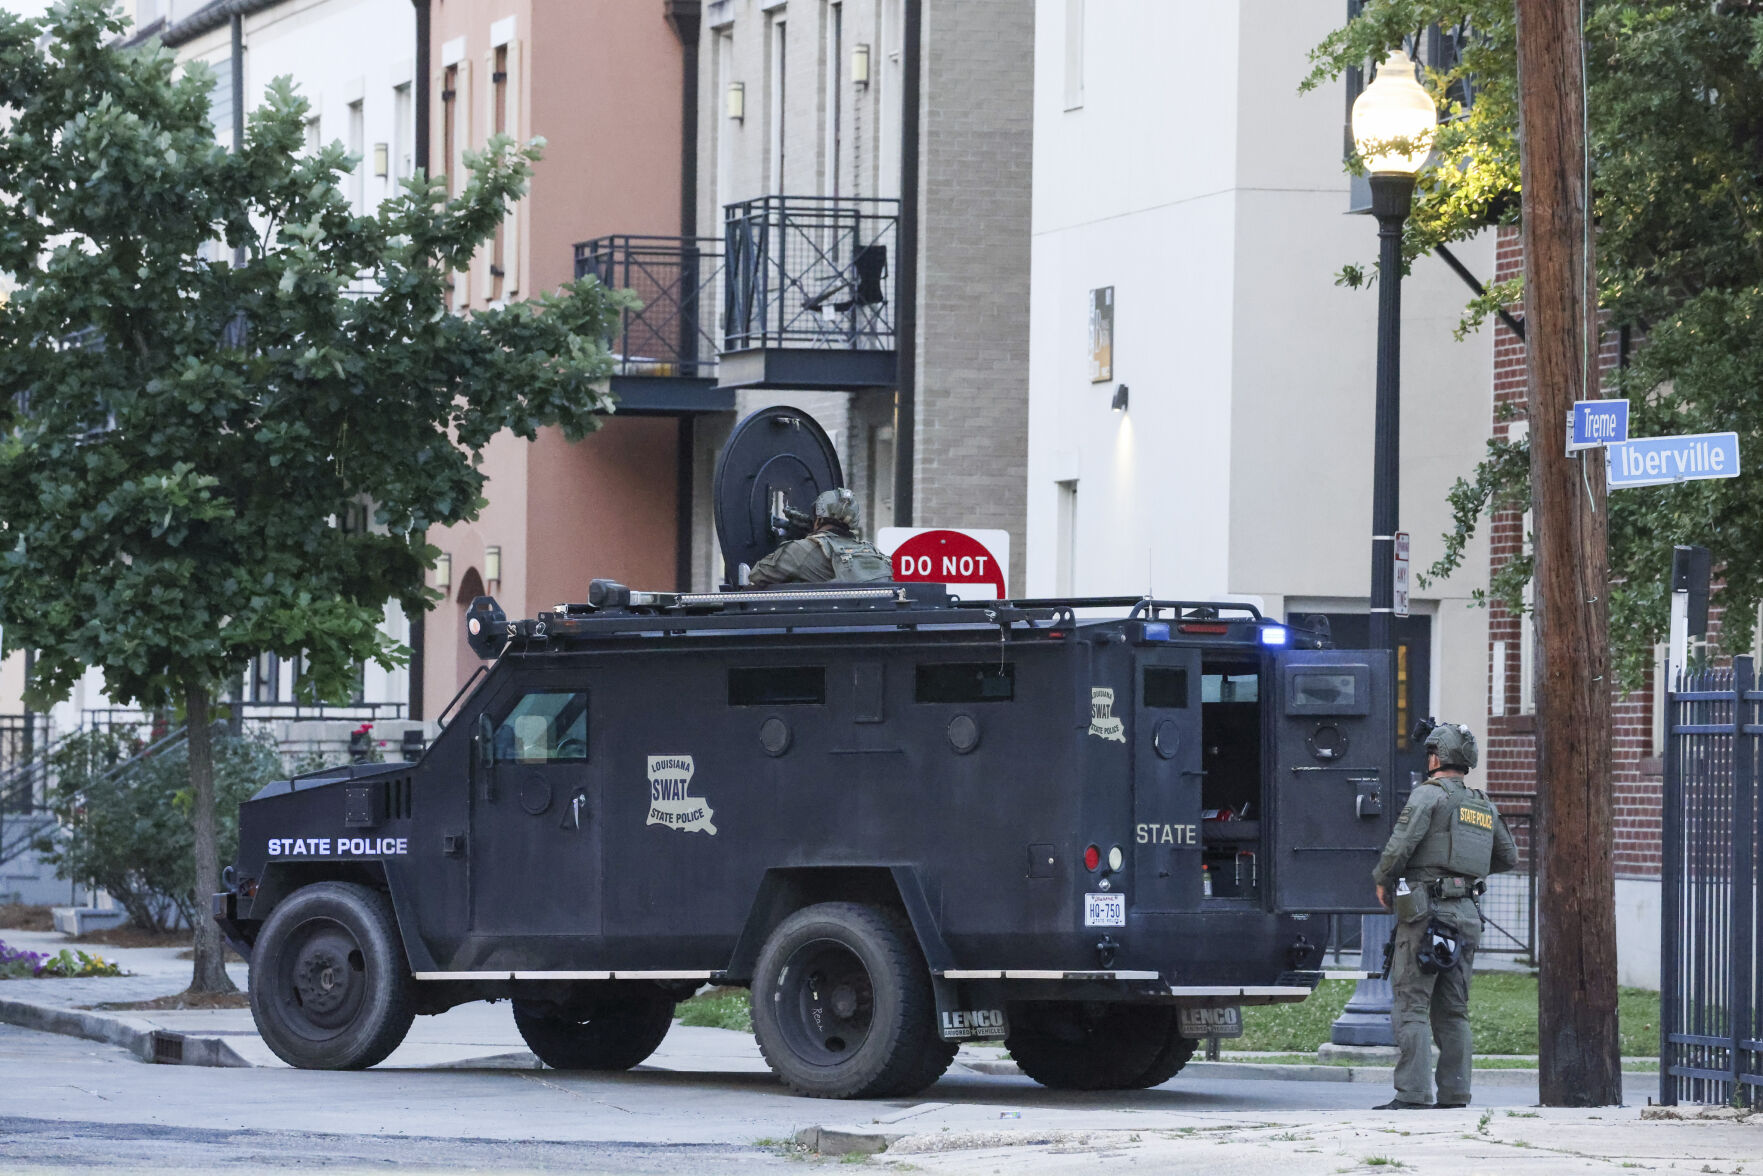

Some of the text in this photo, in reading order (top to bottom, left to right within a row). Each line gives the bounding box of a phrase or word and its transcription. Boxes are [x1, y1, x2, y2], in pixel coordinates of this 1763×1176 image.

[1584, 408, 1617, 438] Treme
[1621, 441, 1725, 476] Iberville
[901, 556, 988, 576] DO NOT
[1091, 703, 1110, 719] SWAT
[651, 759, 690, 773] LOUISIANA
[652, 779, 687, 801] SWAT
[651, 808, 704, 823] STATE POLICE
[1460, 807, 1493, 830] STATE POLICE
[1136, 824, 1196, 844] STATE
[268, 838, 408, 855] STATE POLICE
[942, 1010, 1003, 1028] LENCO
[1181, 1007, 1237, 1025] LENCO
